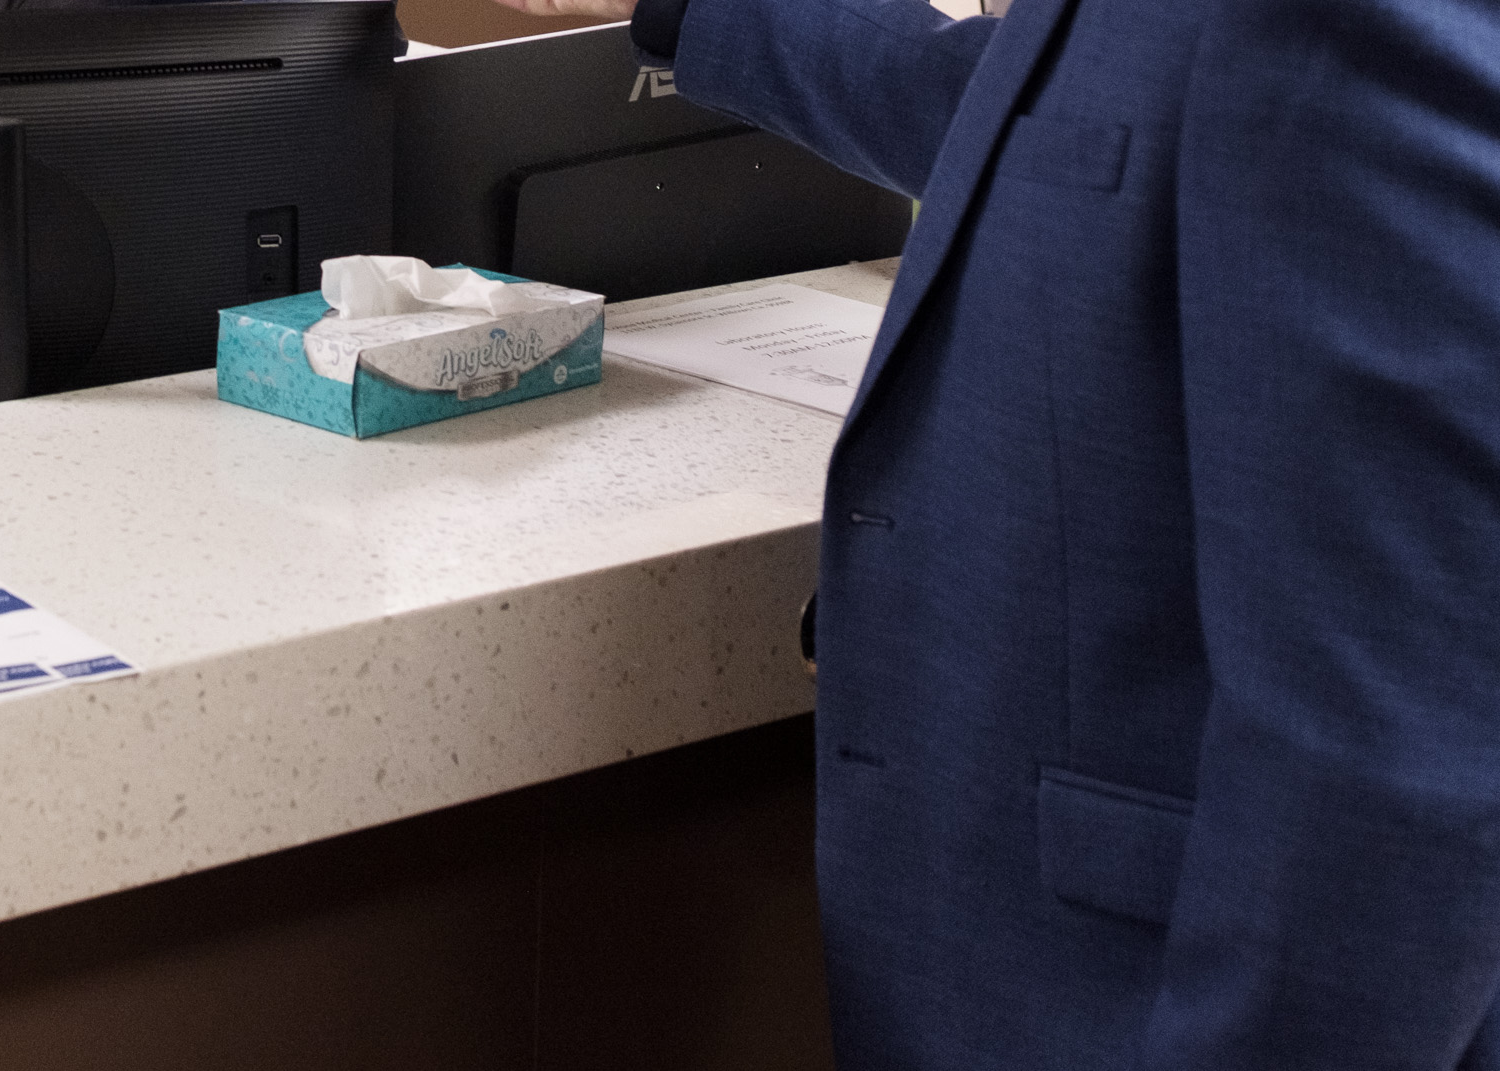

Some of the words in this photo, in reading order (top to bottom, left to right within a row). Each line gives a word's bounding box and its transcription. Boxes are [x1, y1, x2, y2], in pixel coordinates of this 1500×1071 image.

[715, 330, 787, 346] Laboratory
[742, 338, 798, 352] Monday
[804, 328, 848, 340] Friday
